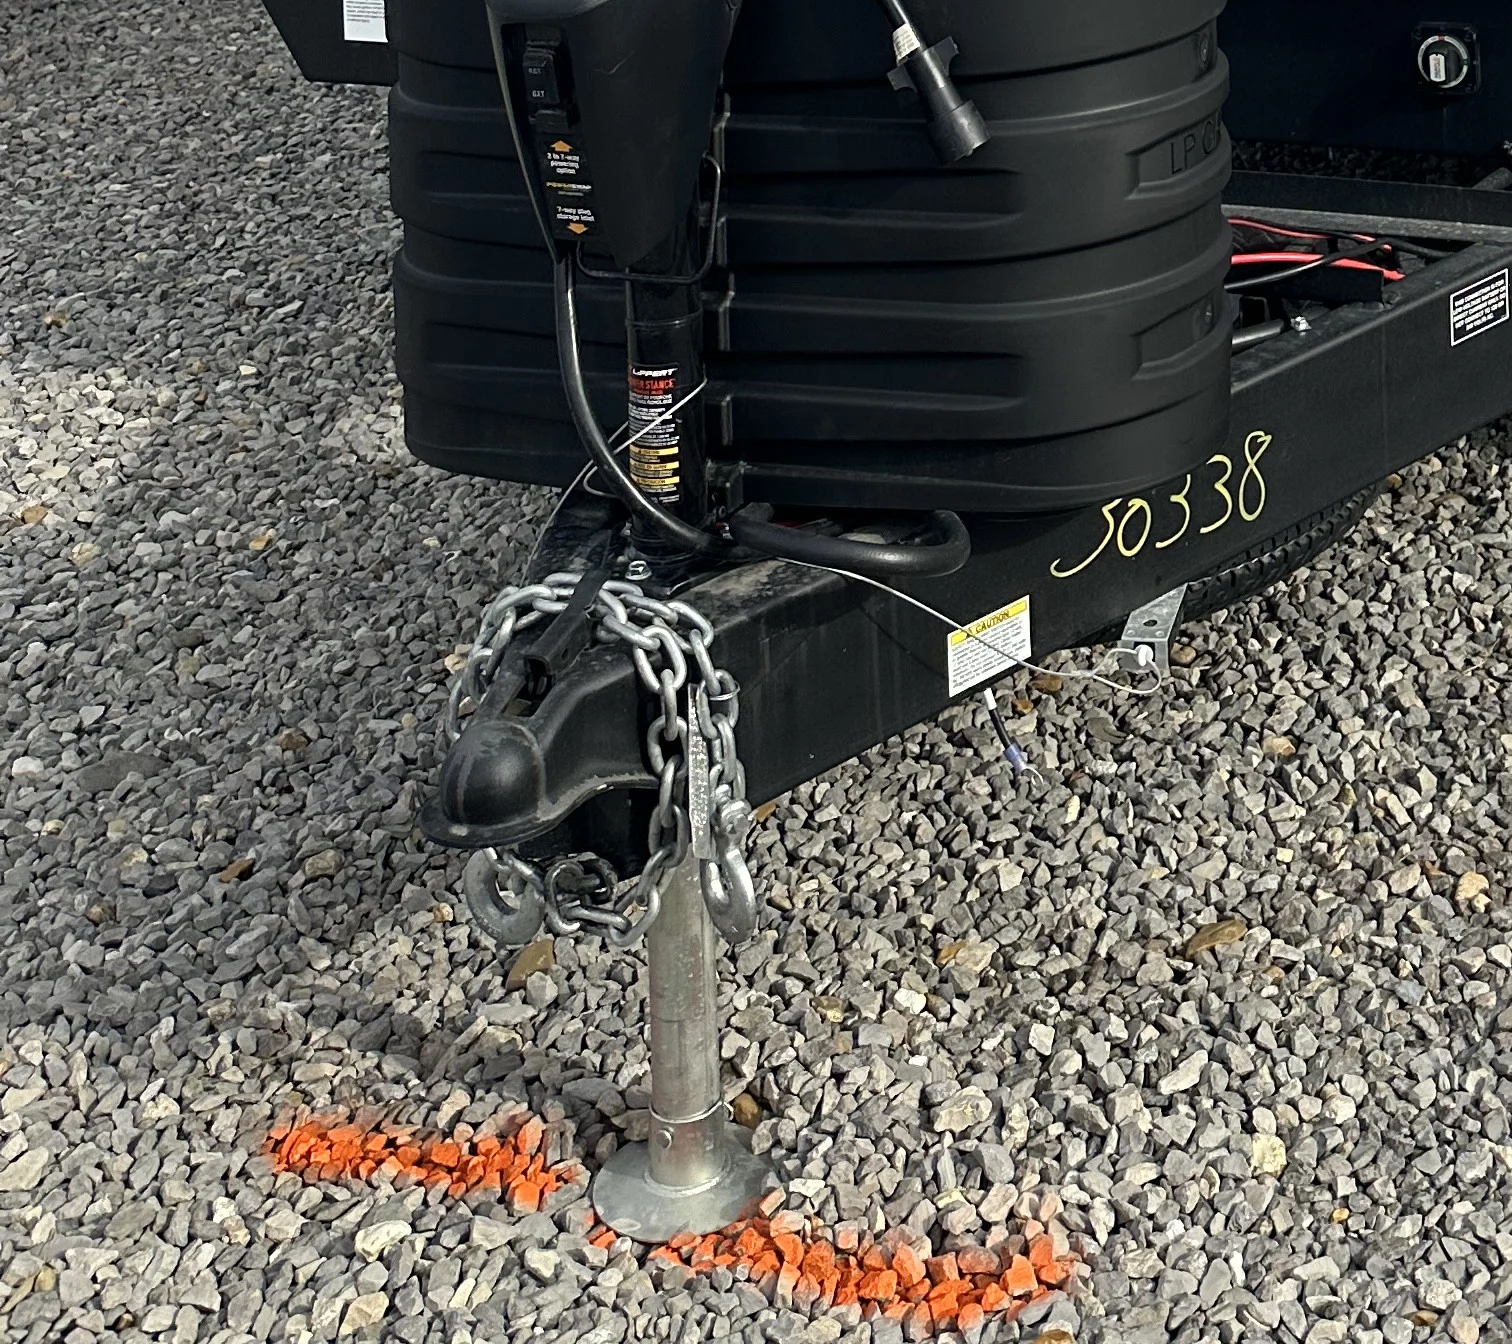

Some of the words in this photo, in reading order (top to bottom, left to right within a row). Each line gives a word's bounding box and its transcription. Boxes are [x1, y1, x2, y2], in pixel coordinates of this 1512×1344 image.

[1170, 133, 1197, 175] LP
[1050, 430, 1272, 578] 50338
[975, 609, 1010, 634] CAUTION
